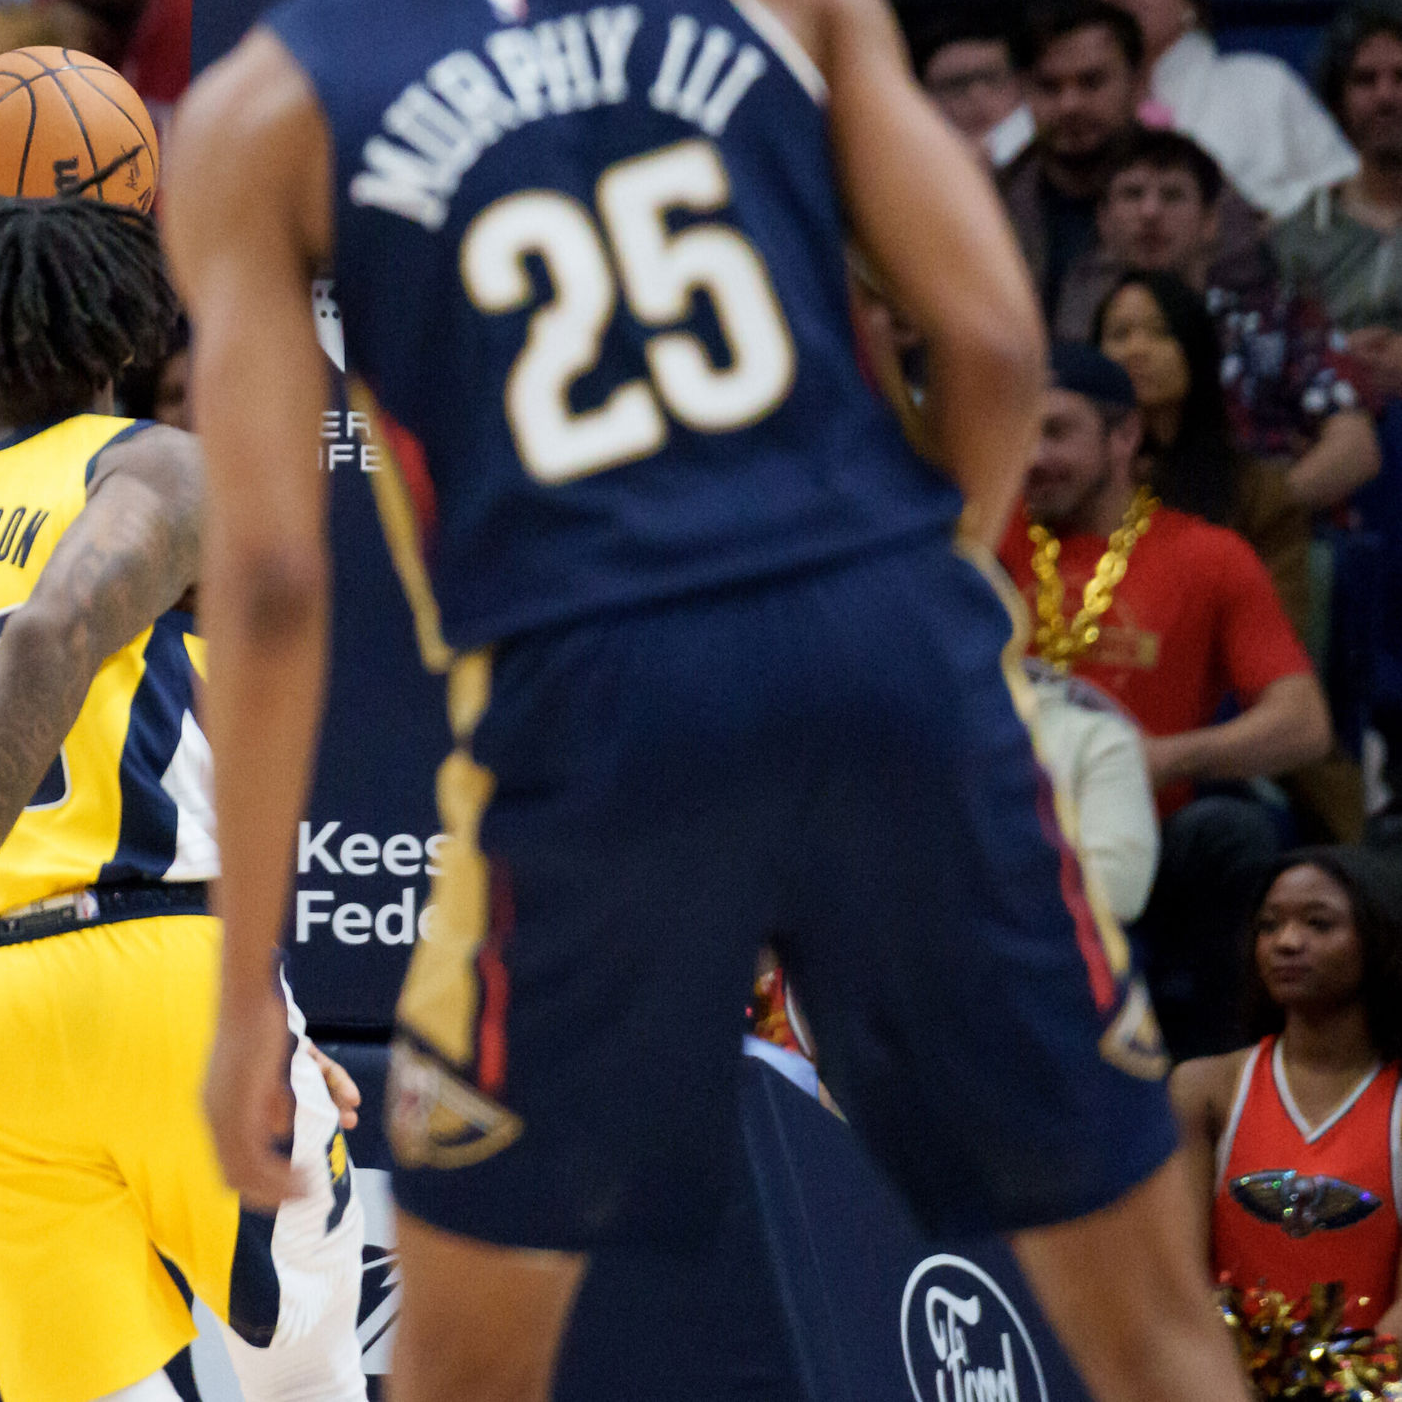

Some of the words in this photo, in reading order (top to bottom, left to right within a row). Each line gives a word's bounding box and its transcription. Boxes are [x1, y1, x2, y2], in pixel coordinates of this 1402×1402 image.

[350, 4, 642, 232] MURPHY
[649, 14, 767, 137] III
[459, 138, 798, 487] 25
